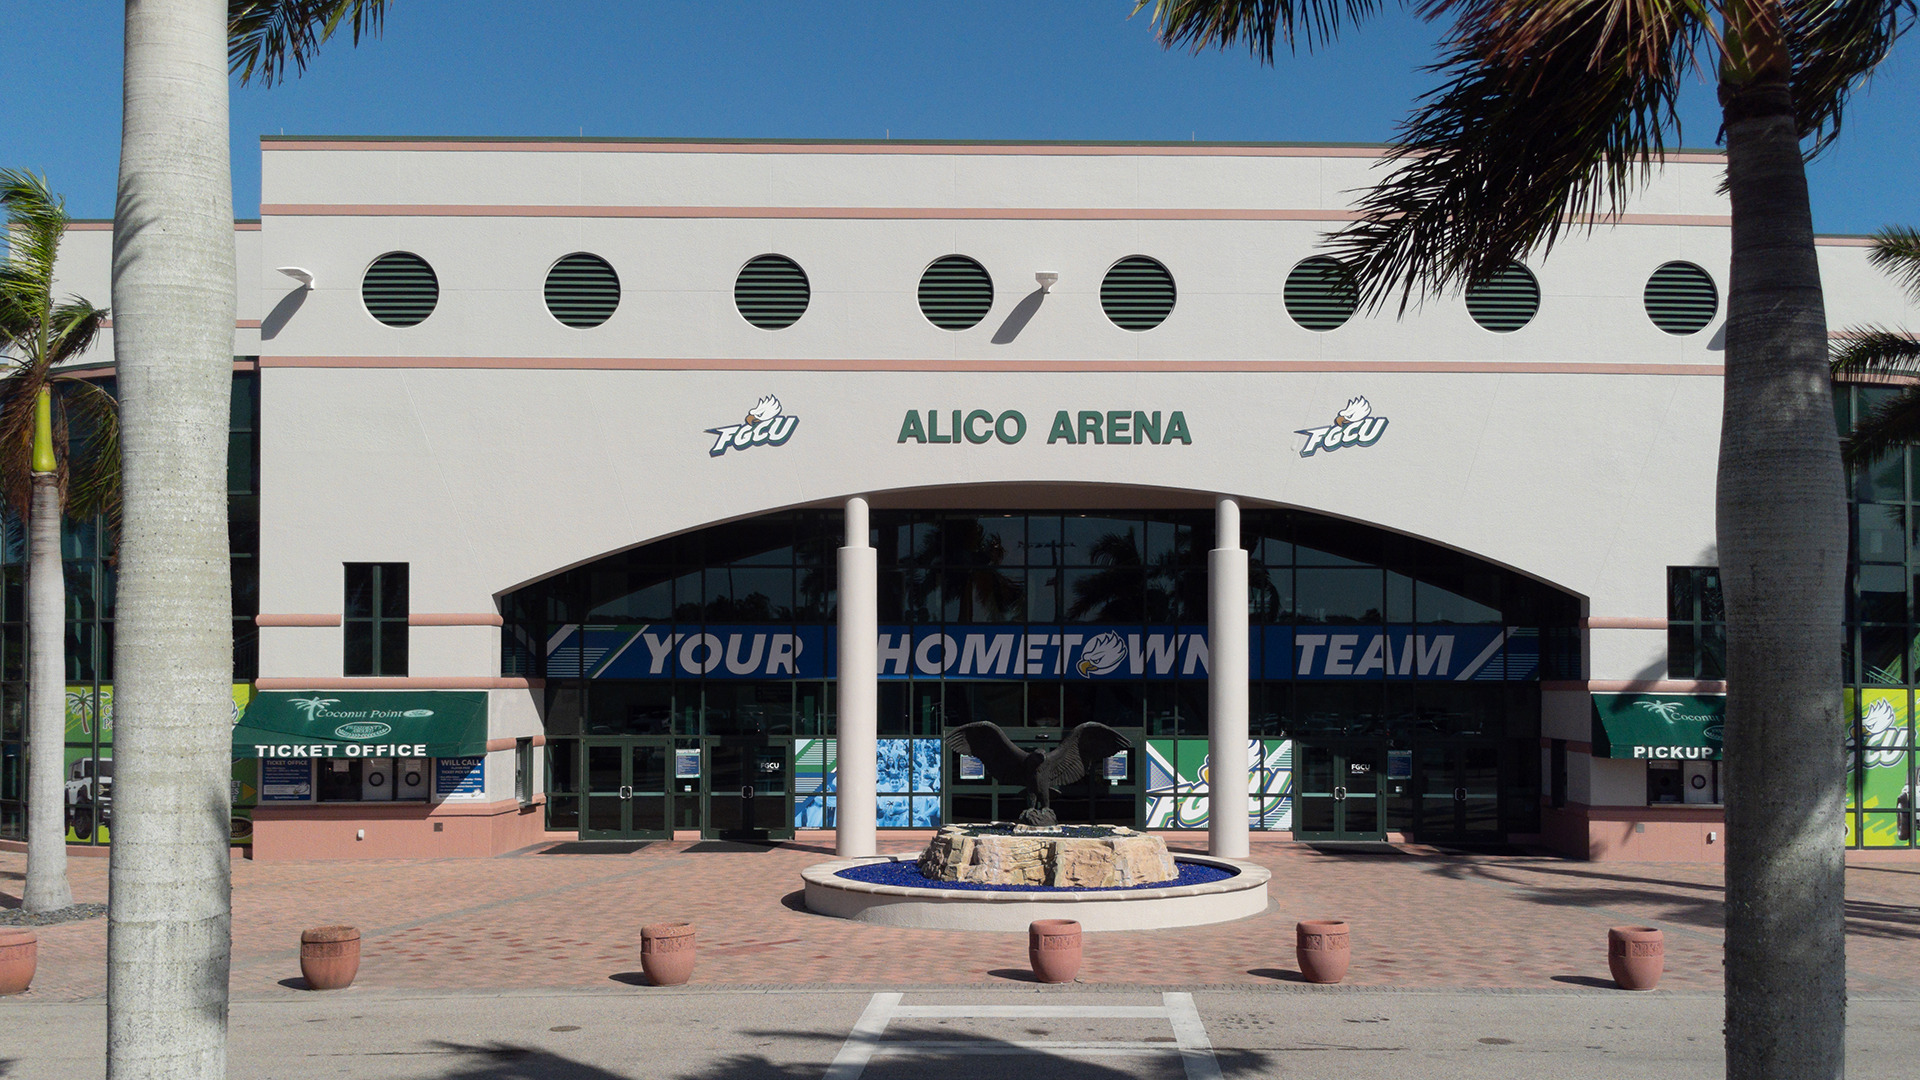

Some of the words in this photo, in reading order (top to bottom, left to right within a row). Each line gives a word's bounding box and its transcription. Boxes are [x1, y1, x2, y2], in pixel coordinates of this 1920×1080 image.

[897, 409, 1028, 445] ALICO
[1046, 409, 1193, 445] ARENA
[704, 414, 800, 458] FGCU
[1294, 416, 1389, 458] FGCU
[642, 632, 804, 675] YOUR
[1295, 634, 1456, 676] TEAM
[316, 708, 367, 718] Coconut
[370, 708, 404, 719] Point
[1670, 712, 1720, 722] Coconut
[255, 744, 338, 758] TICKET
[345, 744, 427, 757] OFFICE
[1633, 746, 1713, 759] PICKUP
[1351, 763, 1371, 771] FGCU
